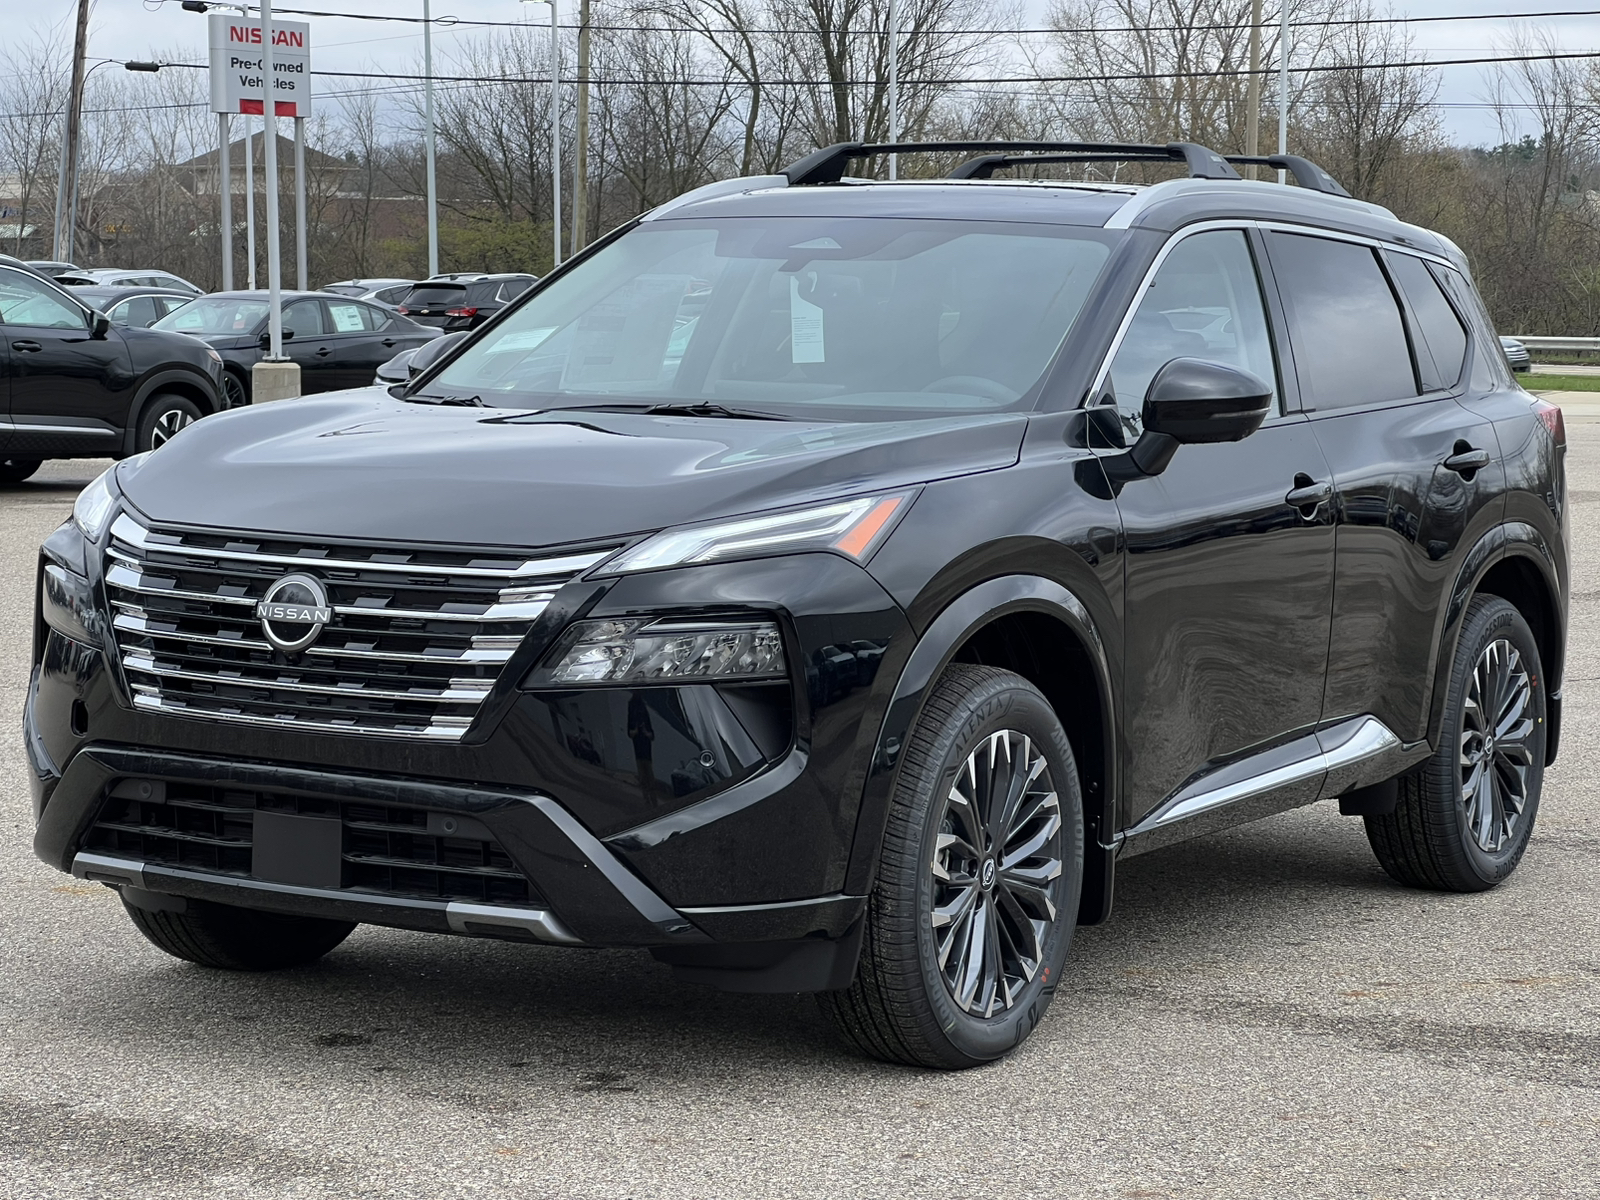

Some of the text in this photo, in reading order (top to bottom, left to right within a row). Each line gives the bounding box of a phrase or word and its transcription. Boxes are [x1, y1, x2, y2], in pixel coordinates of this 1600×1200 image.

[230, 26, 303, 47] NISAN
[239, 75, 295, 90] Vehles
[258, 605, 328, 621] NISSAN
[955, 697, 1003, 757] ALENZA
